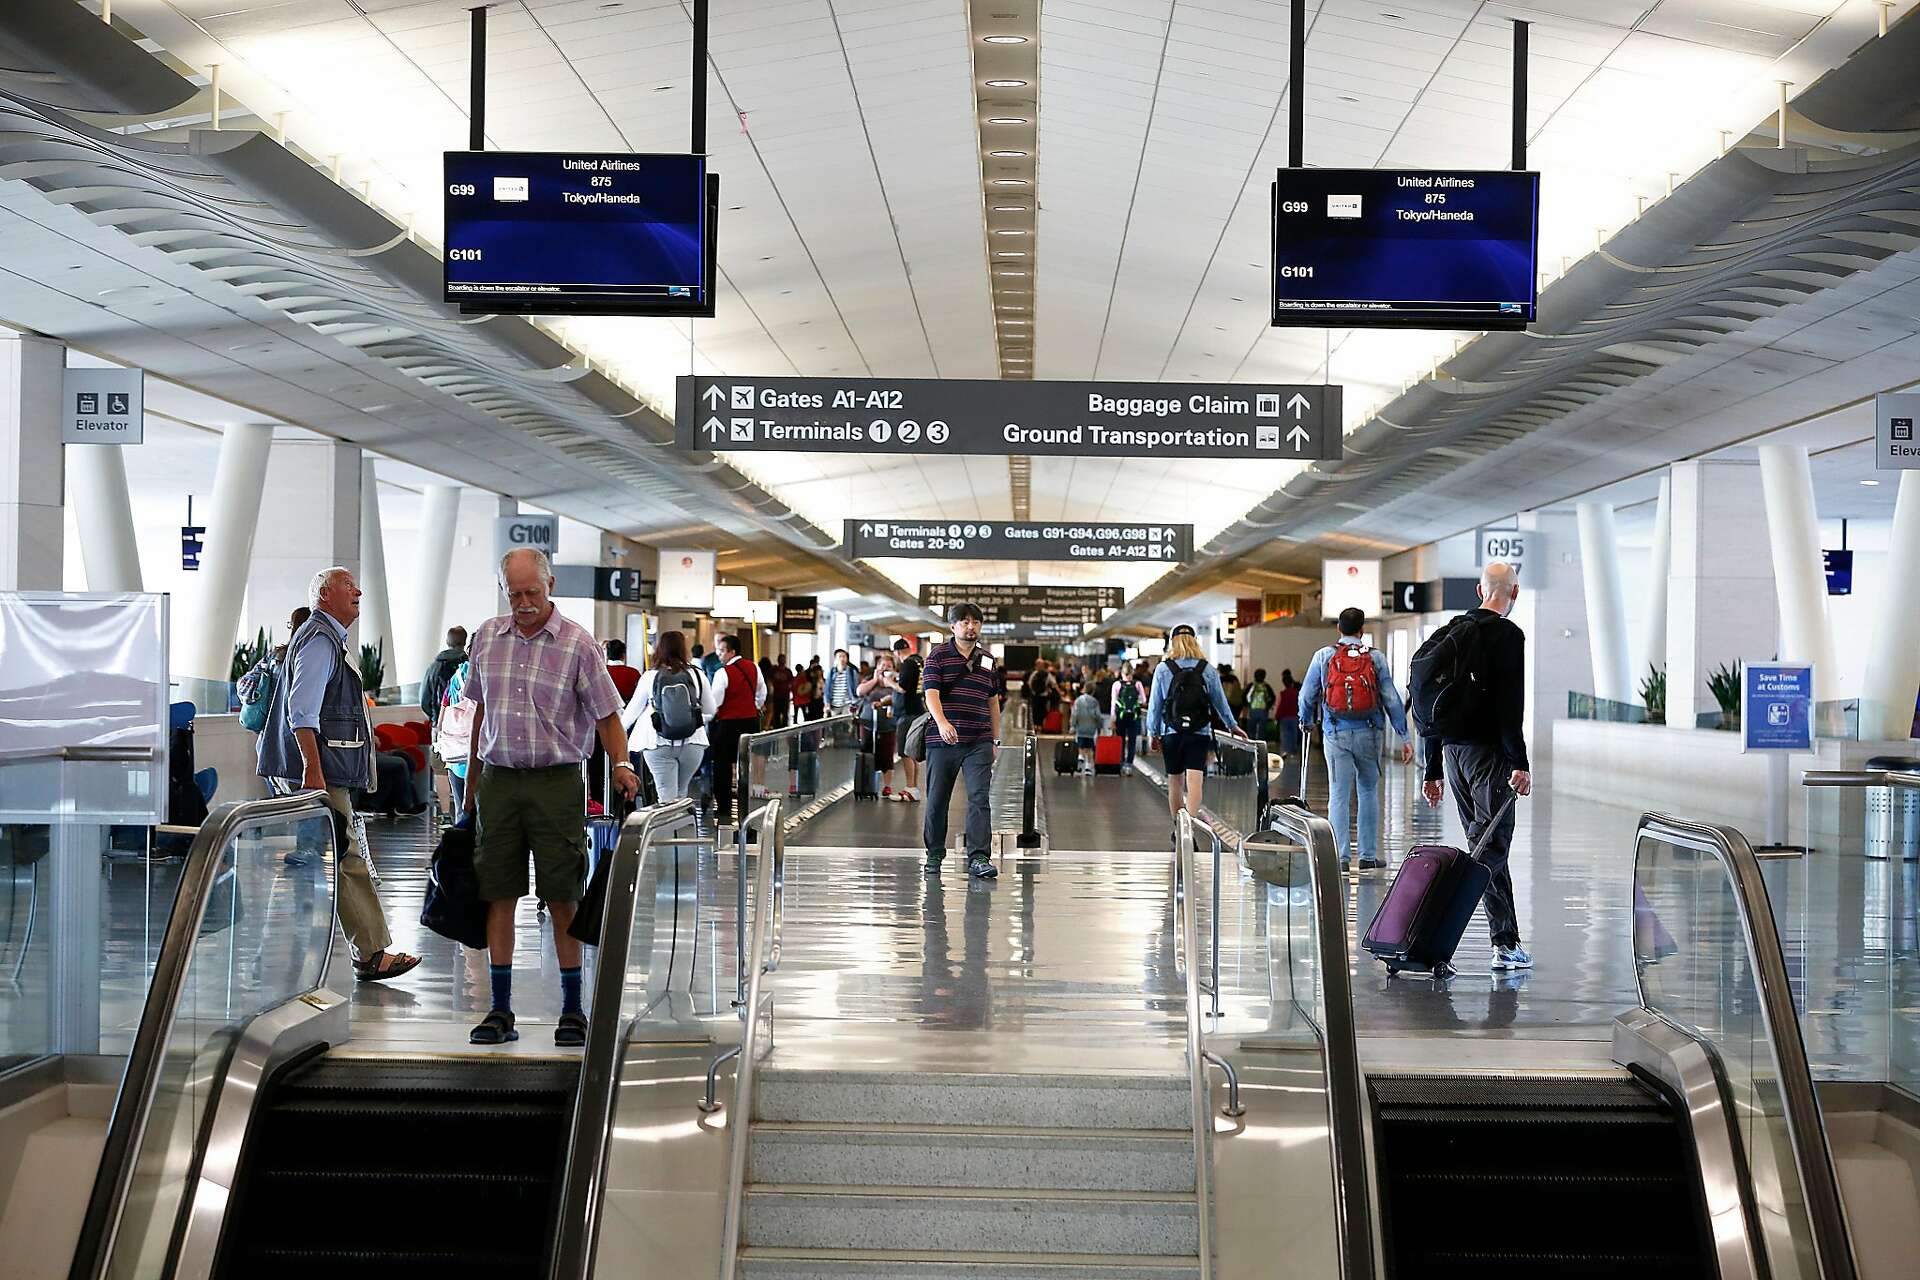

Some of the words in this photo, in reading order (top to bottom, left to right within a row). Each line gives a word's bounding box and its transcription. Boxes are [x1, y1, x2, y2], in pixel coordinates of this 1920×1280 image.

[563, 160, 597, 170] United
[600, 160, 639, 170] Airlines
[591, 177, 611, 186] 875
[1398, 177, 1432, 187] United
[1434, 177, 1474, 187] Airlines
[450, 185, 474, 195] G99
[562, 193, 640, 205] Tokyo/Haneda
[1425, 194, 1445, 203] 875
[1283, 202, 1308, 212] G99
[1396, 210, 1473, 222] Tokyo/Haneda
[450, 249, 481, 260] G101
[1281, 266, 1313, 277] G101
[760, 389, 823, 408] Gates
[832, 390, 902, 408] A1-A12
[1089, 394, 1181, 416] Baggage
[1189, 396, 1248, 414] Claim
[76, 420, 128, 430] Elevator
[760, 419, 863, 440] Terminals
[1004, 424, 1082, 443] Ground
[1088, 426, 1248, 448] Transportation
[509, 524, 551, 544] G100
[890, 525, 946, 539] Terminals
[1005, 527, 1039, 538] Gates
[1043, 528, 1146, 540] G91-G94,G96,G98
[890, 538, 924, 549] Gates
[928, 538, 964, 549] 20-90
[1488, 539, 1525, 557] G95
[1070, 545, 1104, 556] Gates
[1108, 545, 1146, 556] A1-A12
[1767, 683, 1799, 691] Customs
